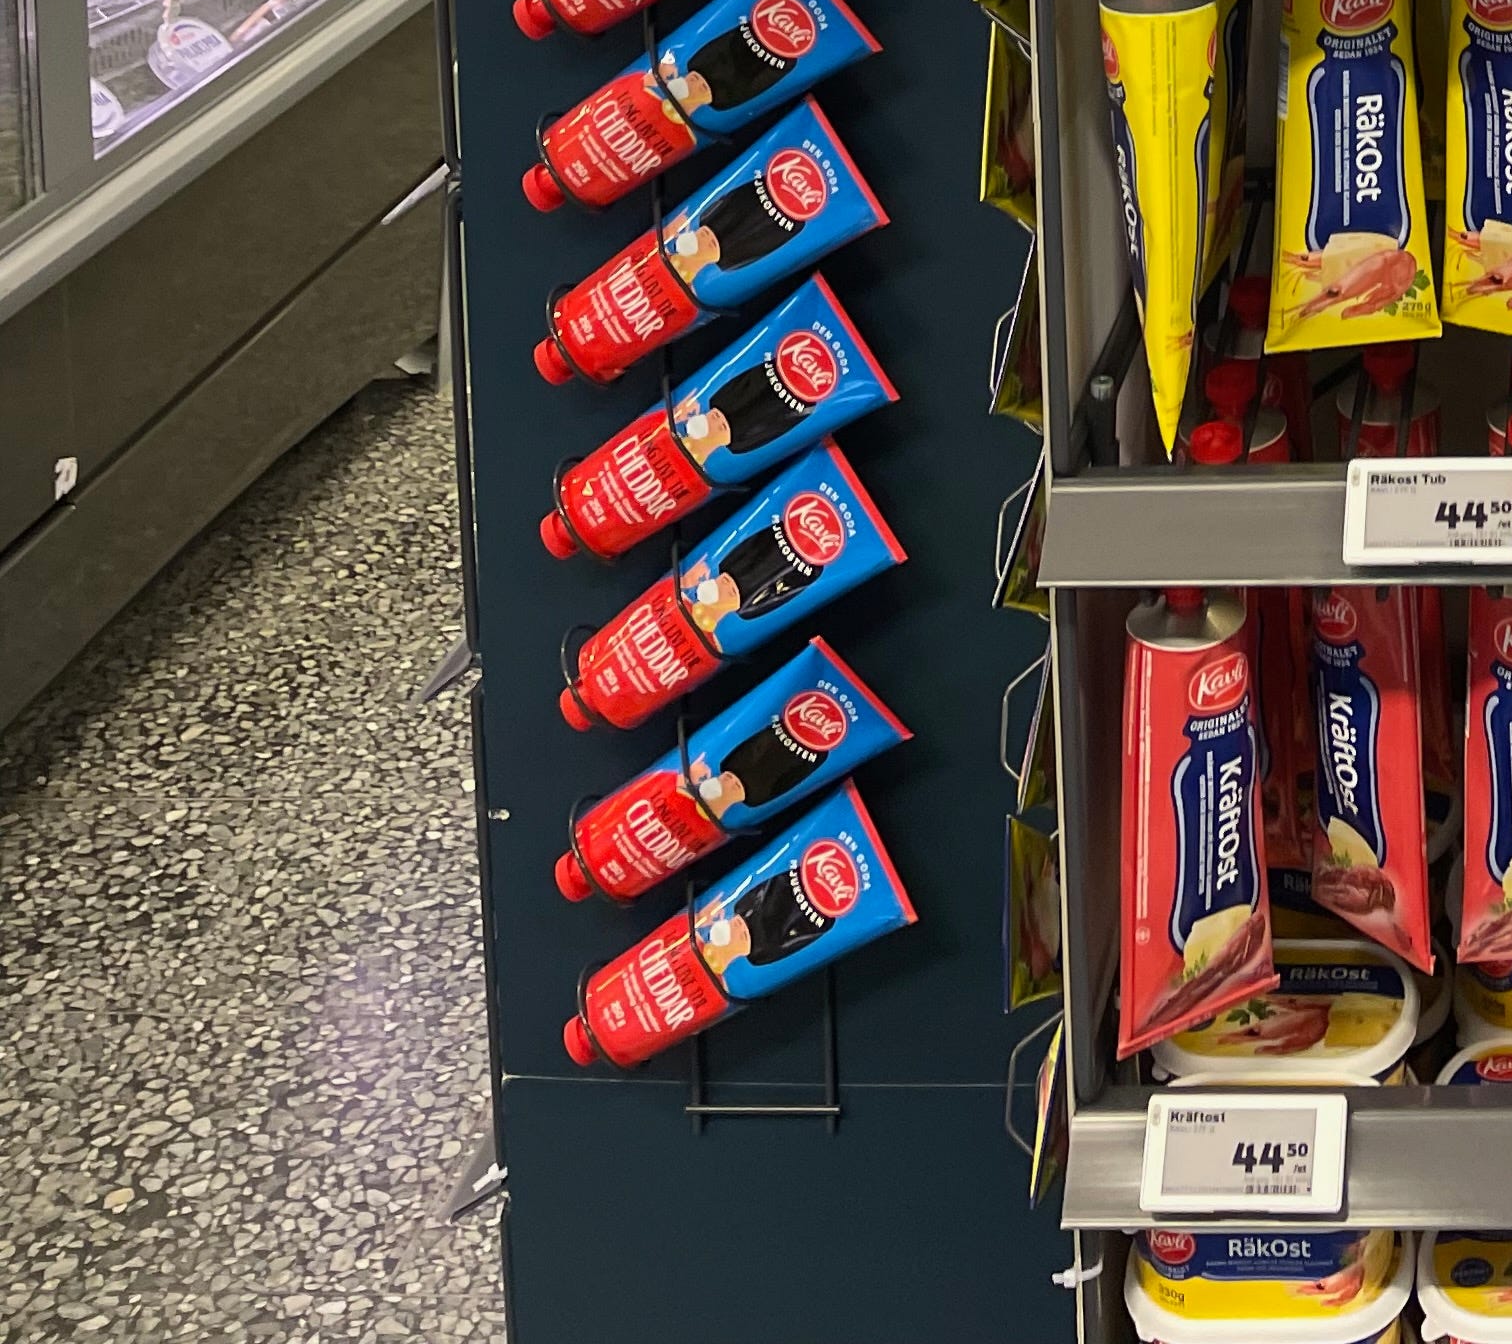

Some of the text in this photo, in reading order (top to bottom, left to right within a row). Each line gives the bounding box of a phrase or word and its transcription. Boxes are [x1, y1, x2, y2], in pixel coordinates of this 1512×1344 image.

[737, 15, 787, 70] MJUKOSTEN
[1323, 26, 1392, 52] ORIGINALET
[590, 99, 663, 178] CHEDDAR
[1356, 93, 1384, 202] RäkOst
[752, 168, 795, 231] MJUKOSTEN
[823, 159, 838, 195] GODA
[763, 351, 805, 413] MJUKOSTEN
[612, 432, 678, 521] CHEDDAR
[1370, 473, 1446, 485] Räkost Tub
[1435, 500, 1512, 530] 44 50
[628, 603, 690, 691] CHEDDAR
[1326, 691, 1360, 814] KräftOst
[1216, 756, 1243, 890] KräftOst
[638, 938, 695, 1031] CHEDDAR
[1290, 967, 1371, 982] RäkOst
[1170, 1111, 1226, 1124] Kräftost
[1232, 1142, 1308, 1174] 44 50
[1227, 1237, 1311, 1258] RäkOst
[1157, 1282, 1185, 1302] 330g
